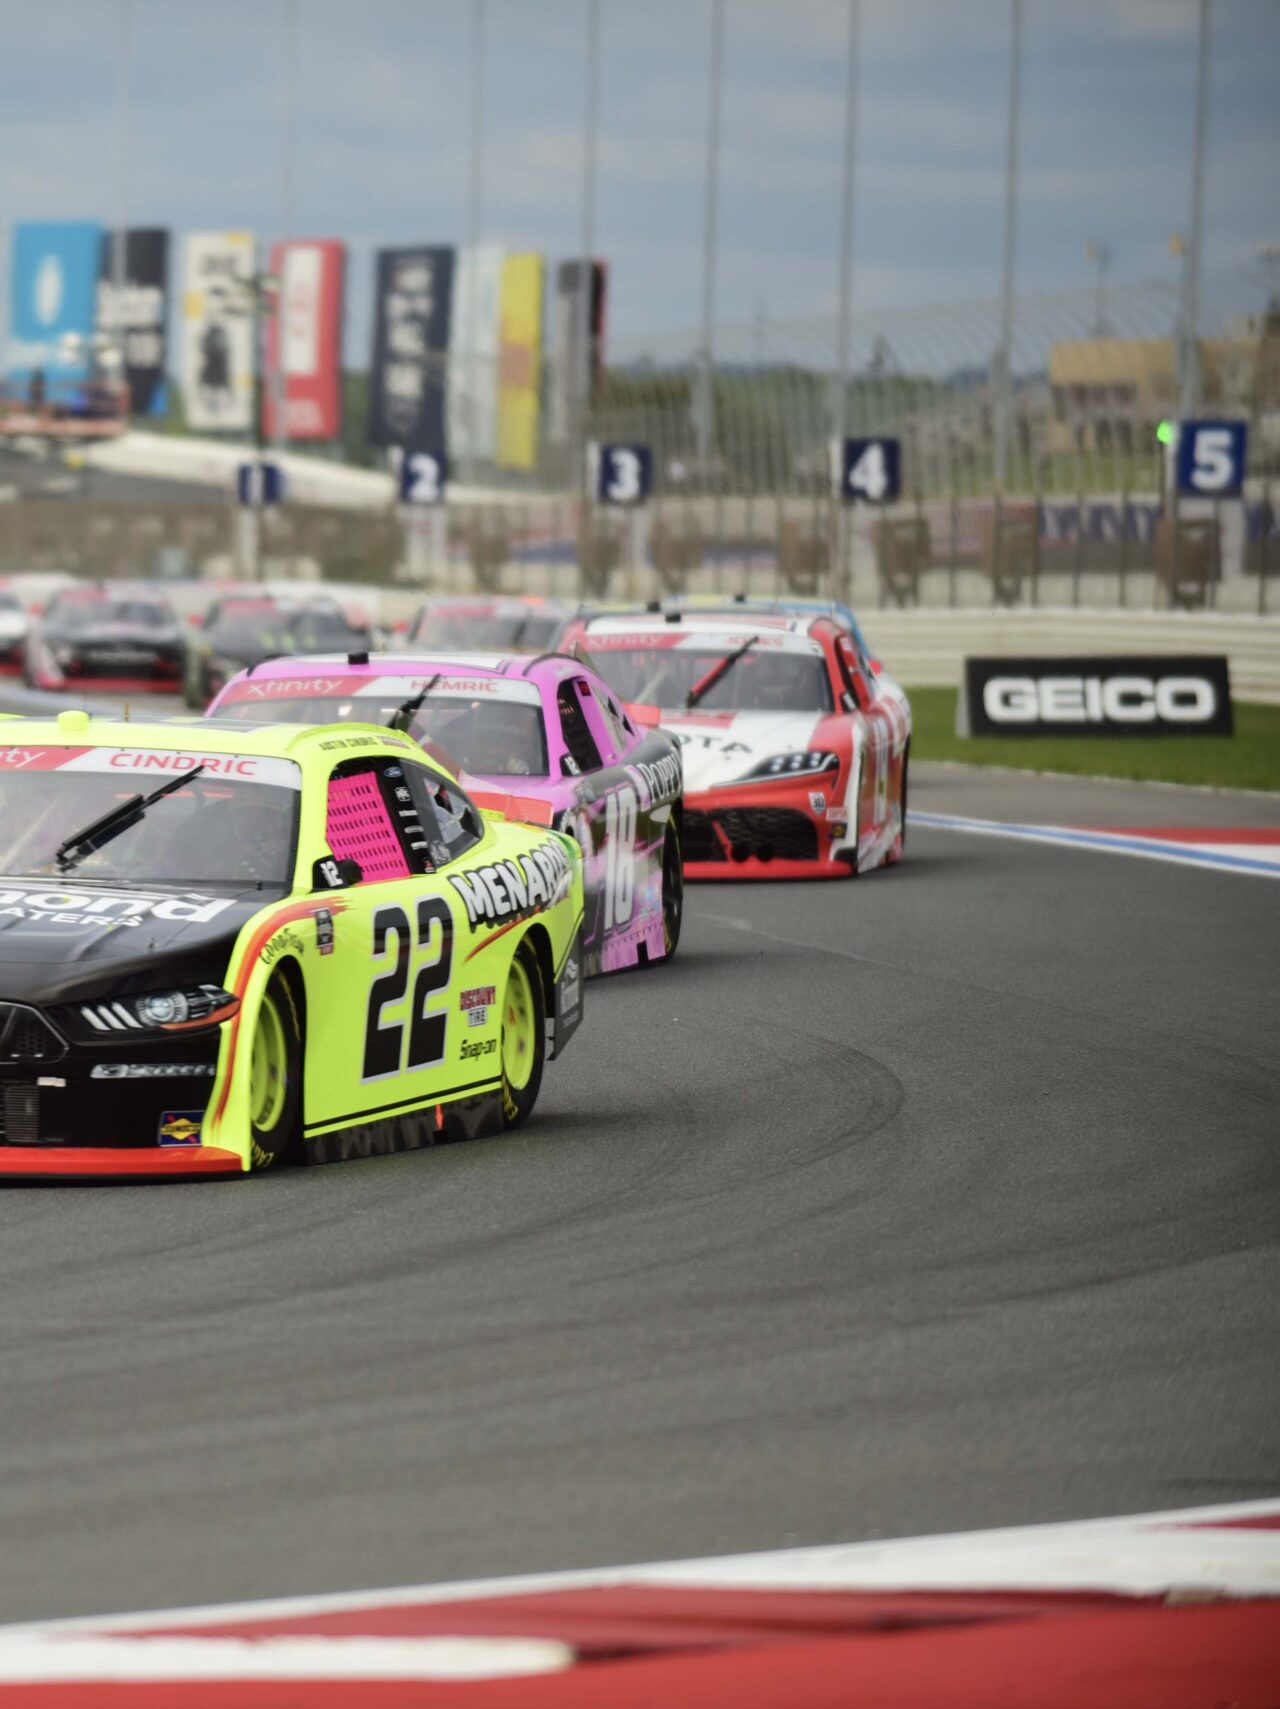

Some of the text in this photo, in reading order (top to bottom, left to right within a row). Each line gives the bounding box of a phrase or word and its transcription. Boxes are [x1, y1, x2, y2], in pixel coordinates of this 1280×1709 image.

[409, 454, 440, 501] 2
[607, 448, 641, 499] 3
[850, 442, 888, 498] 4
[1191, 428, 1234, 490] 5
[410, 678, 500, 693] HEMRIC
[983, 675, 1216, 722] GEICO
[110, 752, 258, 776] CINDRIC
[360, 892, 455, 1085] 22
